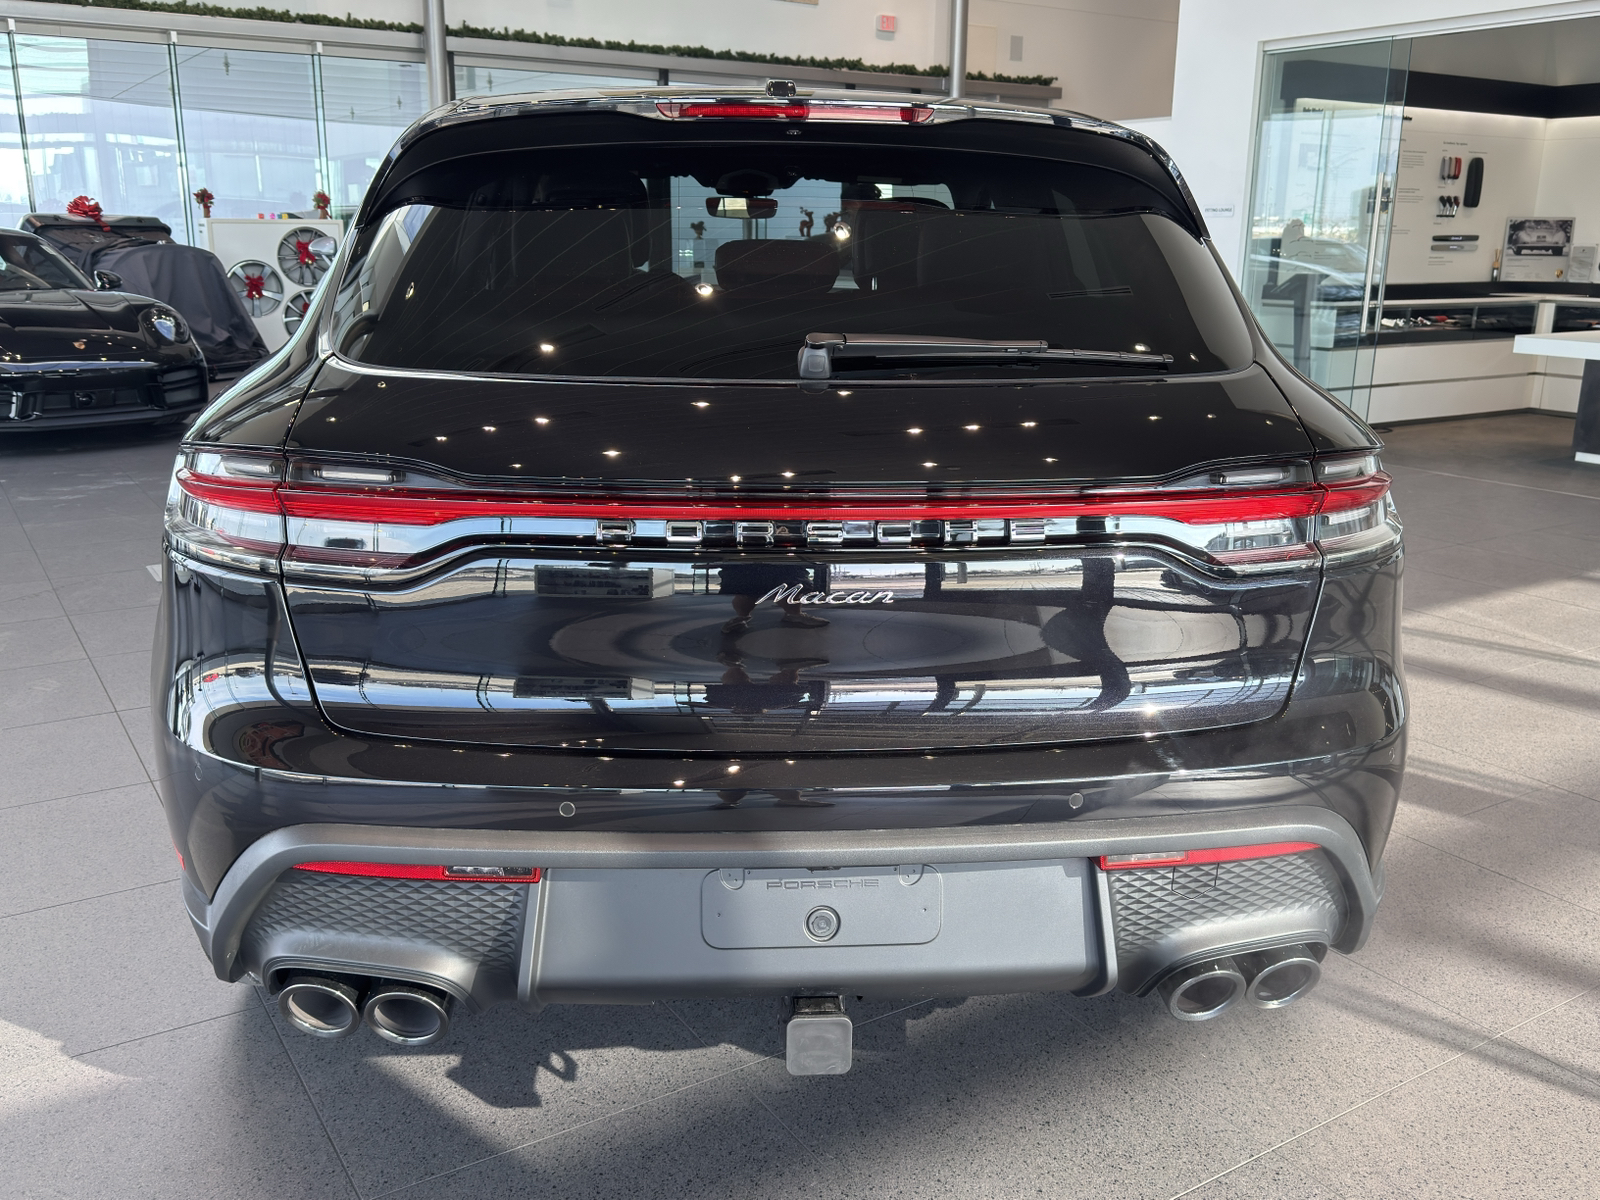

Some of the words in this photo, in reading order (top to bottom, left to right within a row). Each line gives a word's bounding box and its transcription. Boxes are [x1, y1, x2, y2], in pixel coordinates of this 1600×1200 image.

[881, 16, 895, 30] EXIT
[595, 519, 1046, 547] PORSCHE
[754, 582, 895, 605] Macan
[766, 878, 880, 890] PORSCHE
